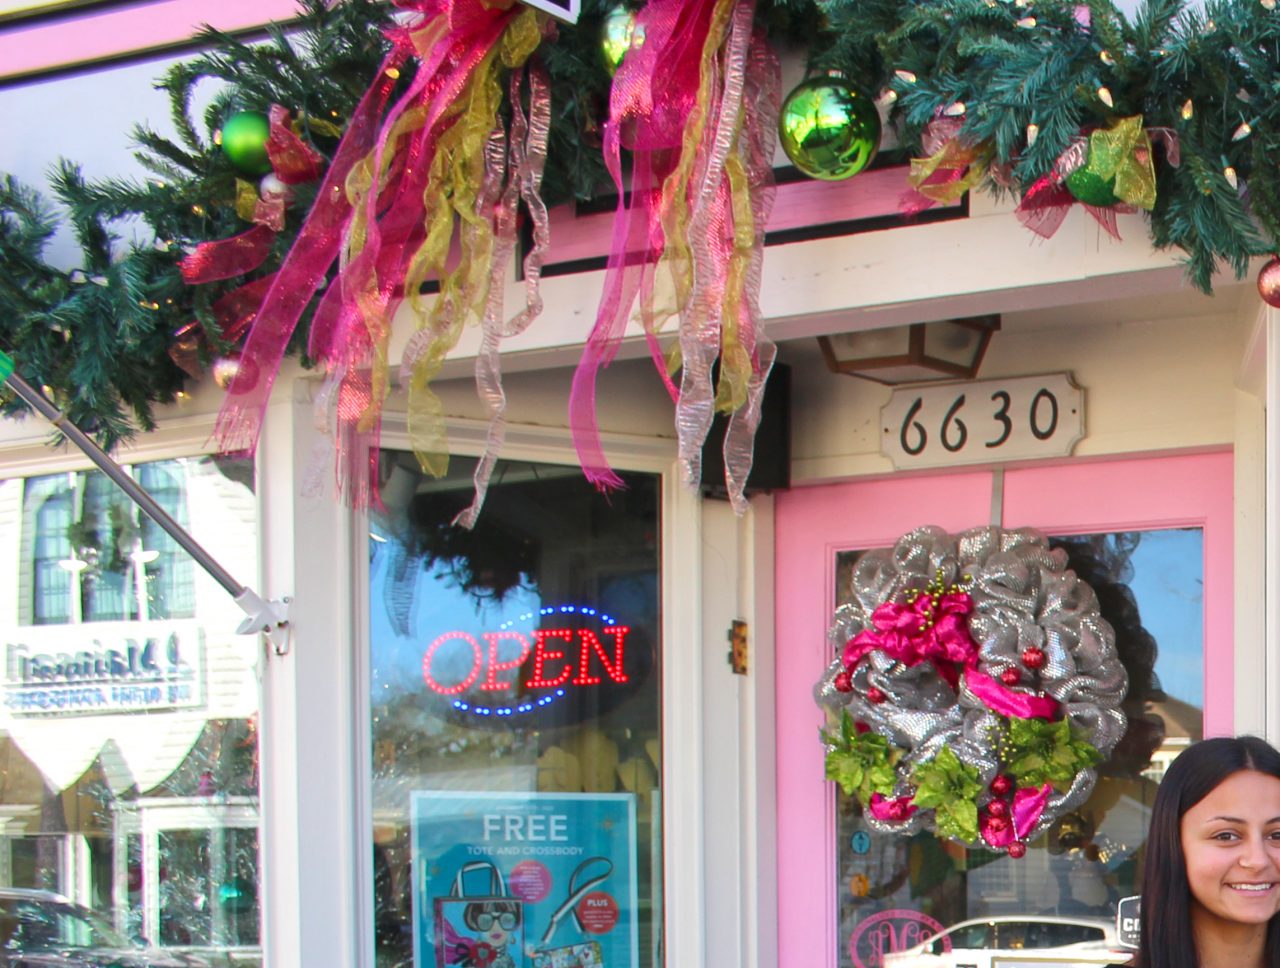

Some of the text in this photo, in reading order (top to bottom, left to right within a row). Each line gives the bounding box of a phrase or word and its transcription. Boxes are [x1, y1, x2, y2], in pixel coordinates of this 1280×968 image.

[900, 388, 1058, 456] 6630
[422, 626, 630, 695] OPEN
[483, 814, 569, 841] FREE
[467, 846, 585, 856] TOTE AND CROSSBODY
[587, 899, 608, 907] PLUS
